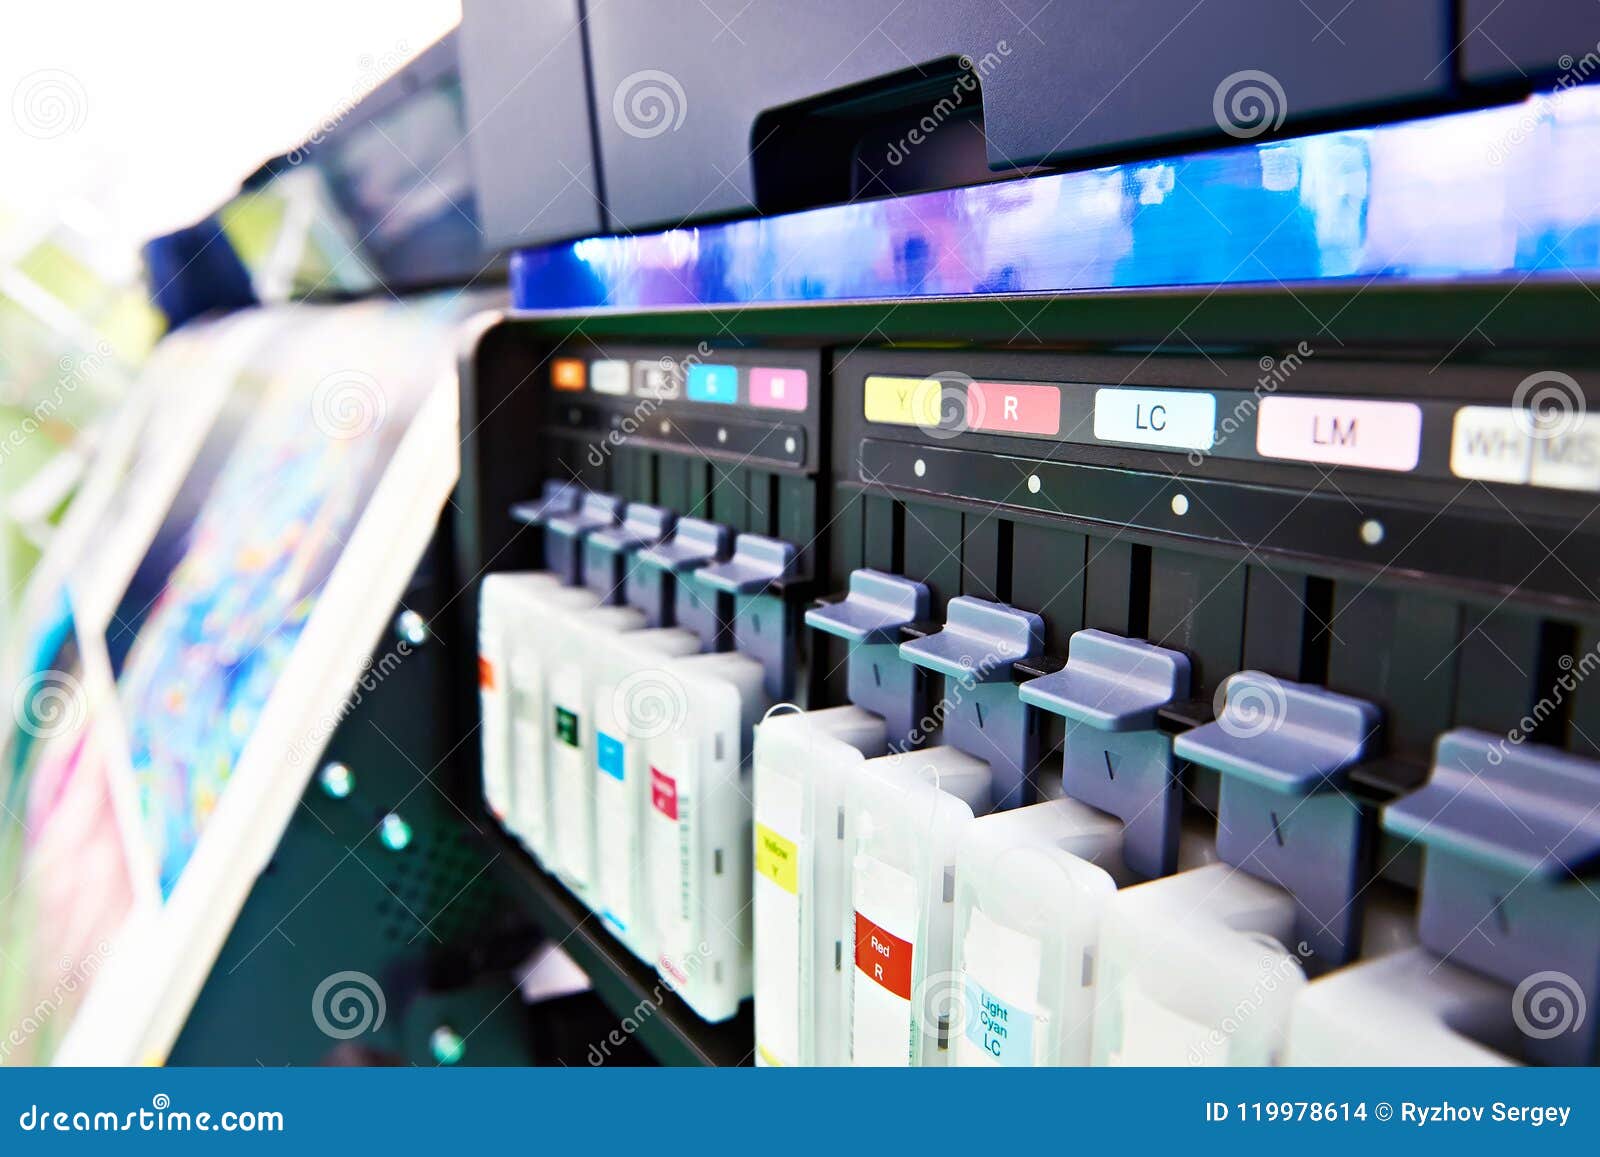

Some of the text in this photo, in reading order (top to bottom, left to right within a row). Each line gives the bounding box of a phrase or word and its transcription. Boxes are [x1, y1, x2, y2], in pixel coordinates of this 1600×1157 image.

[897, 390, 908, 409] Y
[1003, 395, 1019, 421] R
[1135, 403, 1167, 431] LC
[1312, 415, 1358, 447] LM
[871, 935, 890, 958] Red
[874, 962, 884, 981] R
[981, 993, 1008, 1022] Light
[980, 1010, 1008, 1039] Cyan
[984, 1033, 1001, 1056] LC
